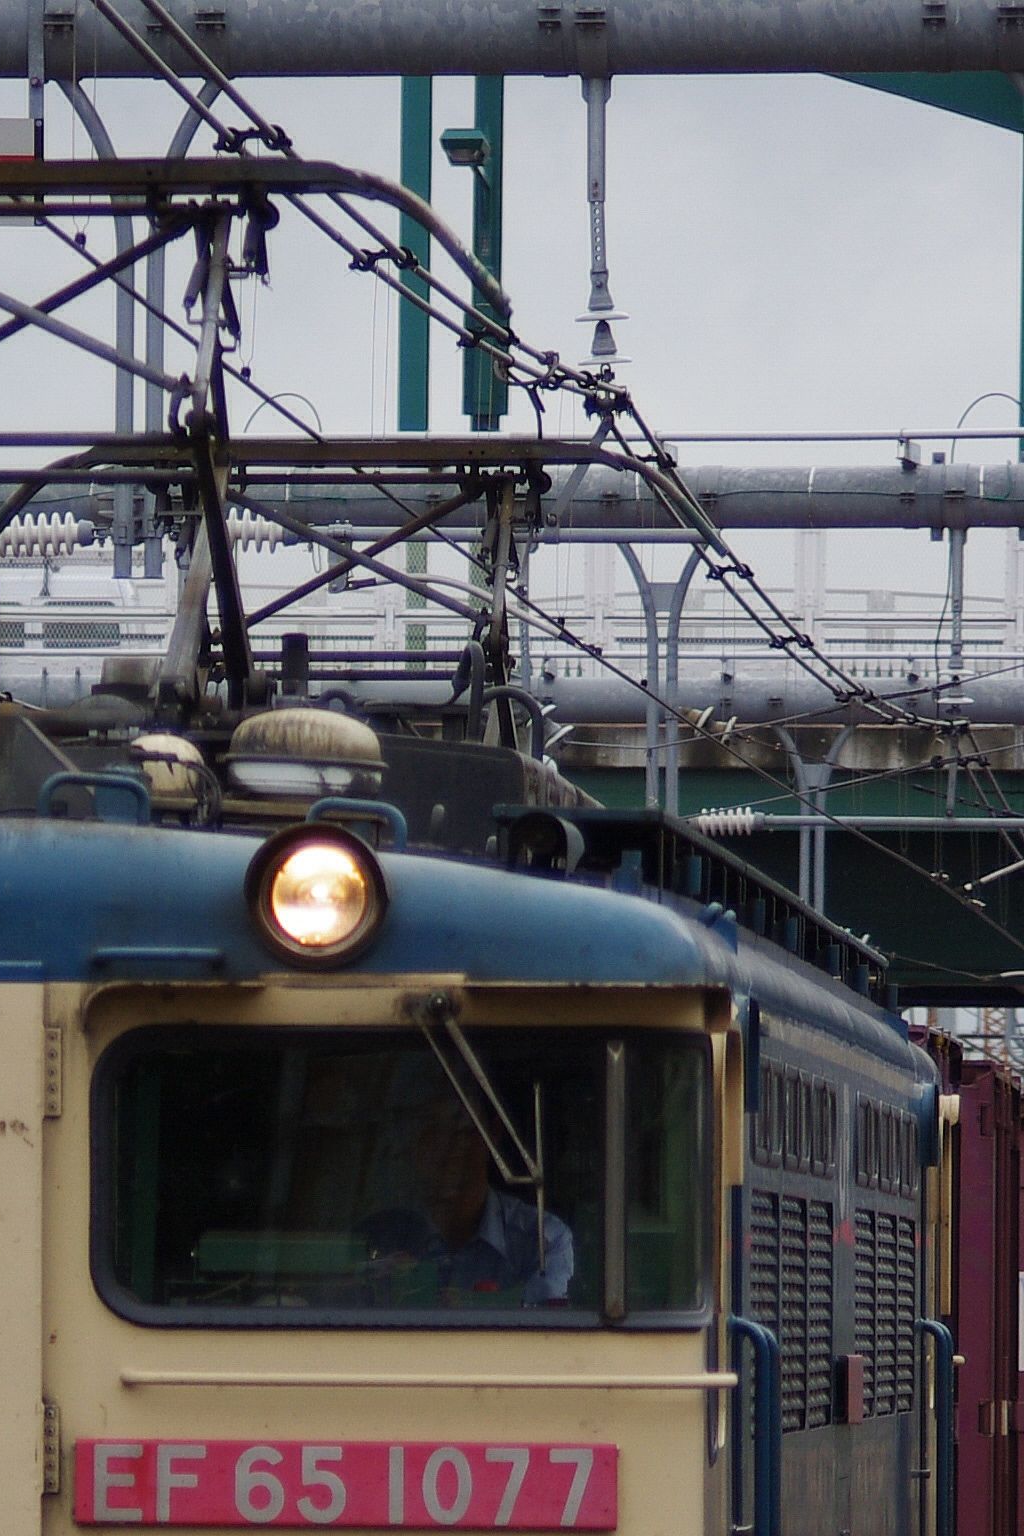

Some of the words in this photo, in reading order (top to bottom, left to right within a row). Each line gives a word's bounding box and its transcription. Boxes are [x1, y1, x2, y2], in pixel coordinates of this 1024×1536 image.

[93, 1444, 206, 1522] EF
[235, 1446, 347, 1525] 65
[388, 1446, 595, 1527] 1077
